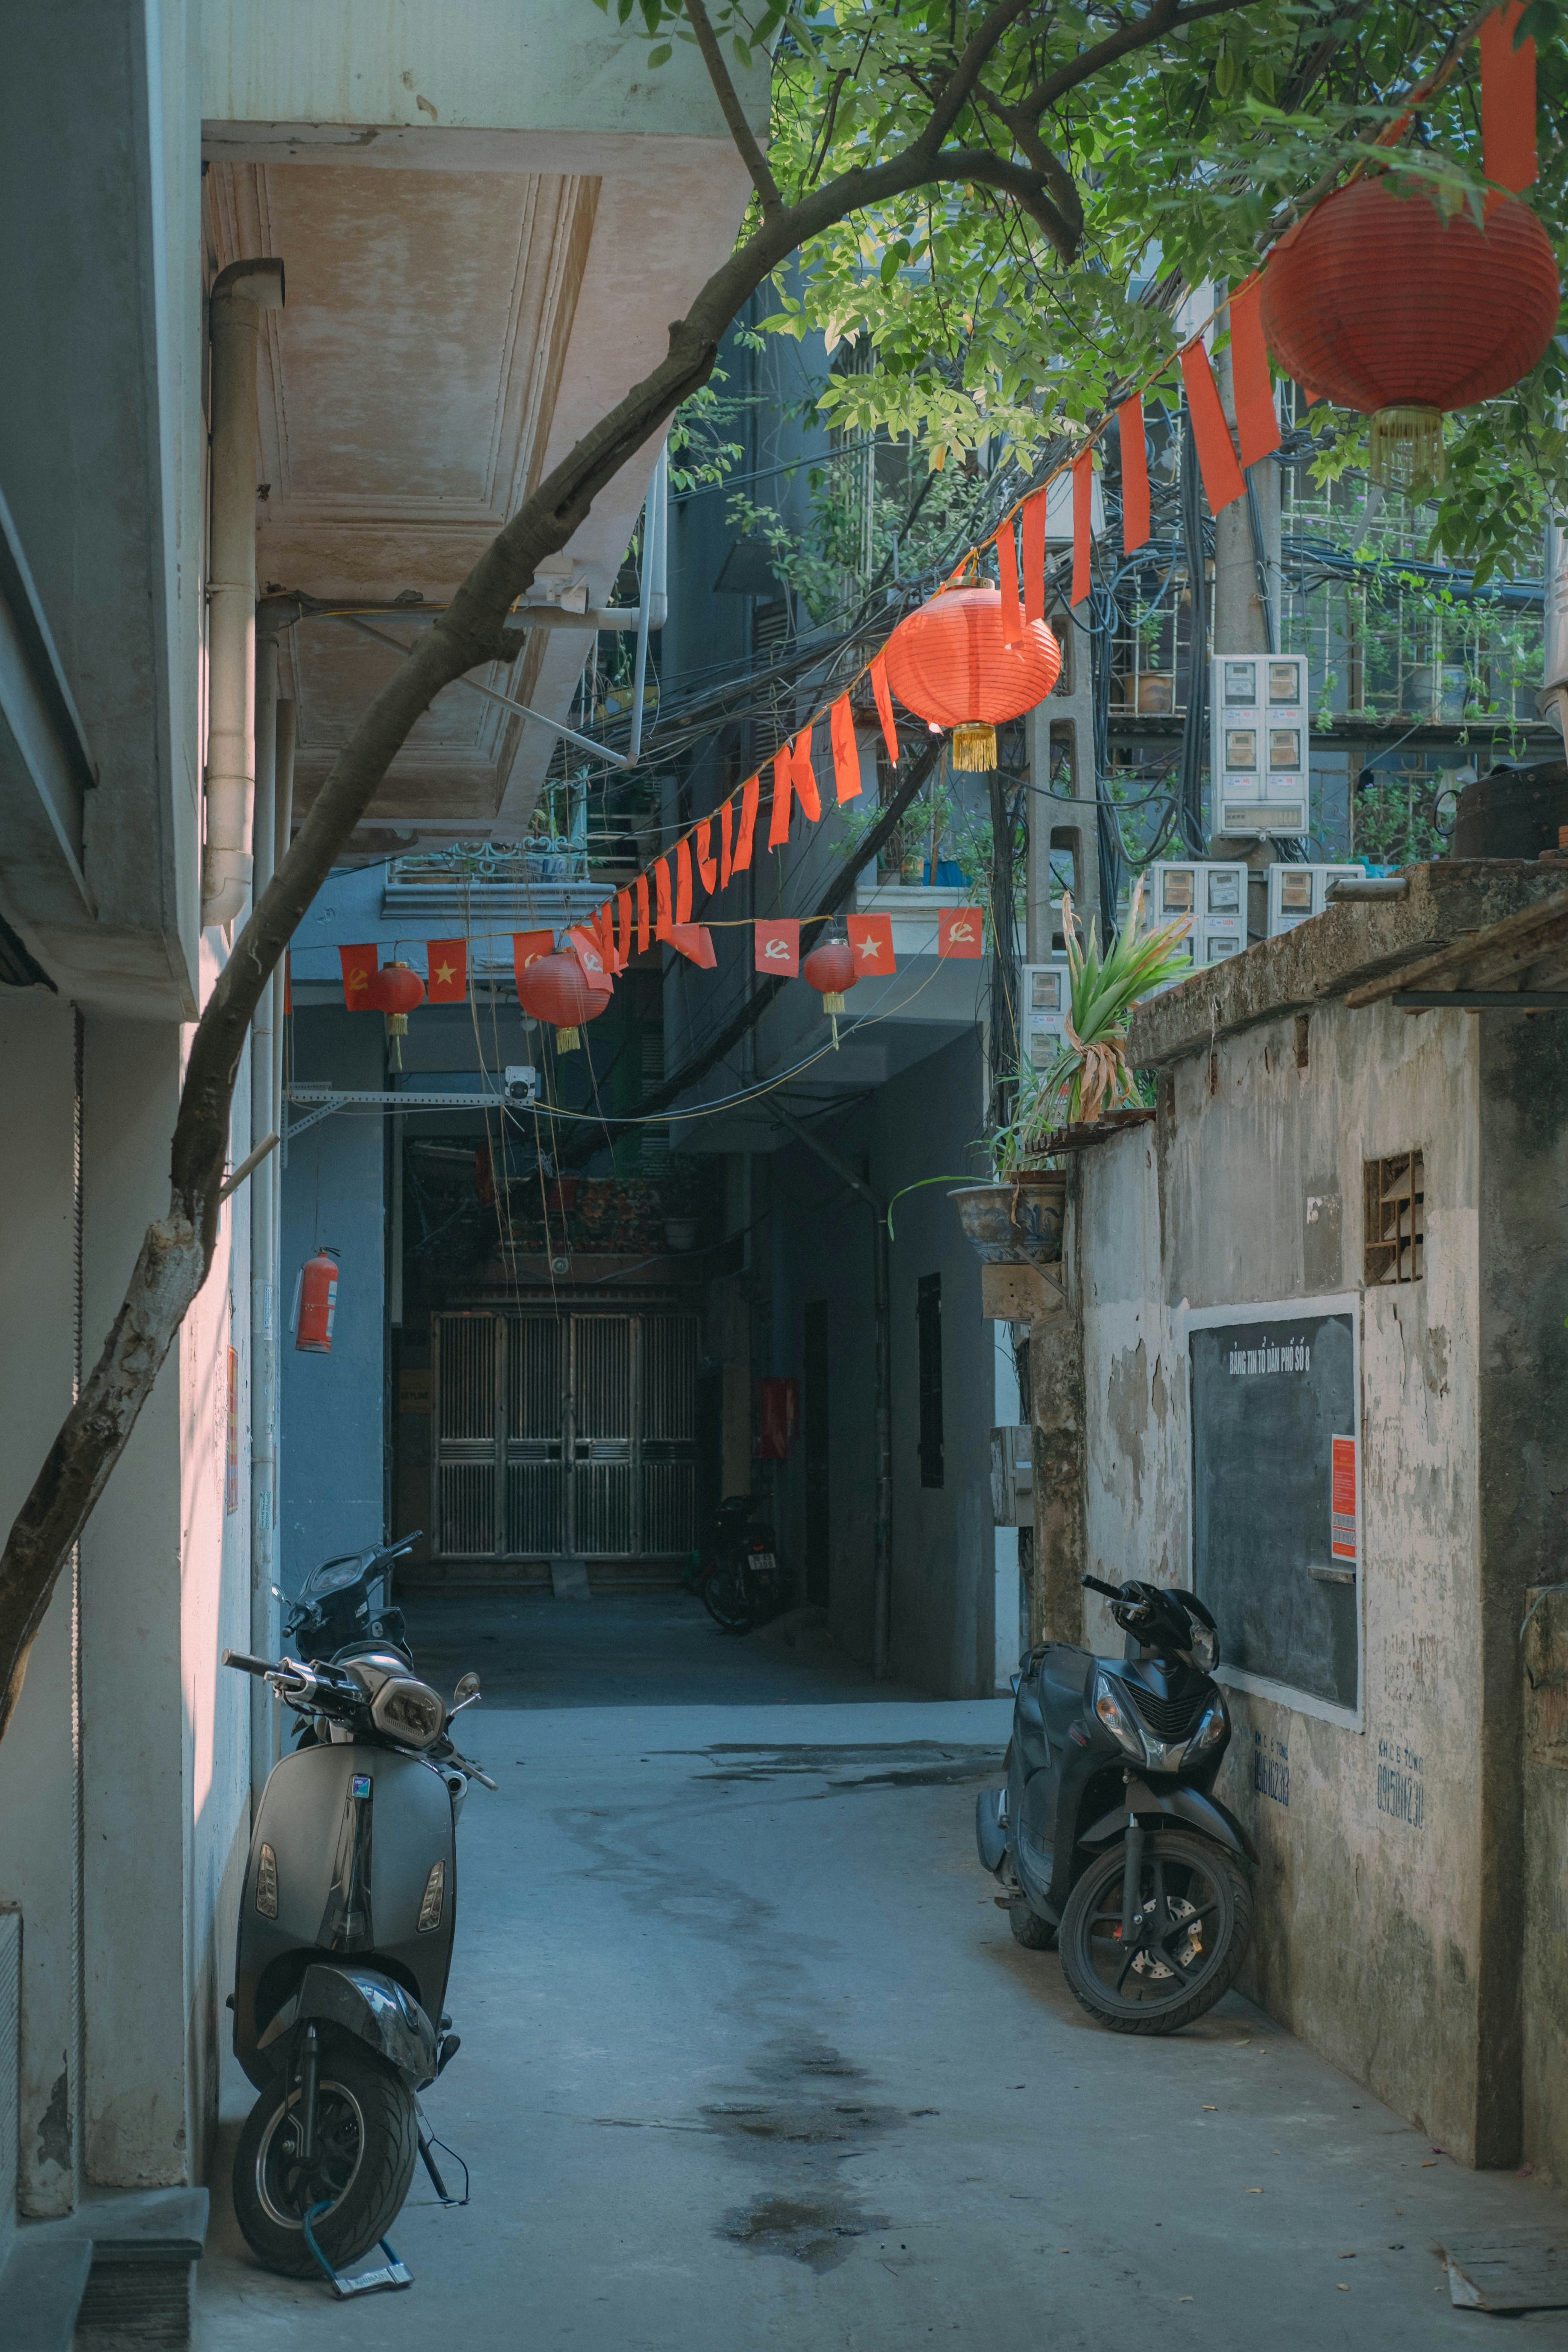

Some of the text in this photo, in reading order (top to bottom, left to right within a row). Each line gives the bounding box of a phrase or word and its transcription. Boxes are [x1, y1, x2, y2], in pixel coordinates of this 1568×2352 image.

[1229, 1336, 1310, 1375] BẢNG TIN TỔ DÂN PHỐ SỐ 8
